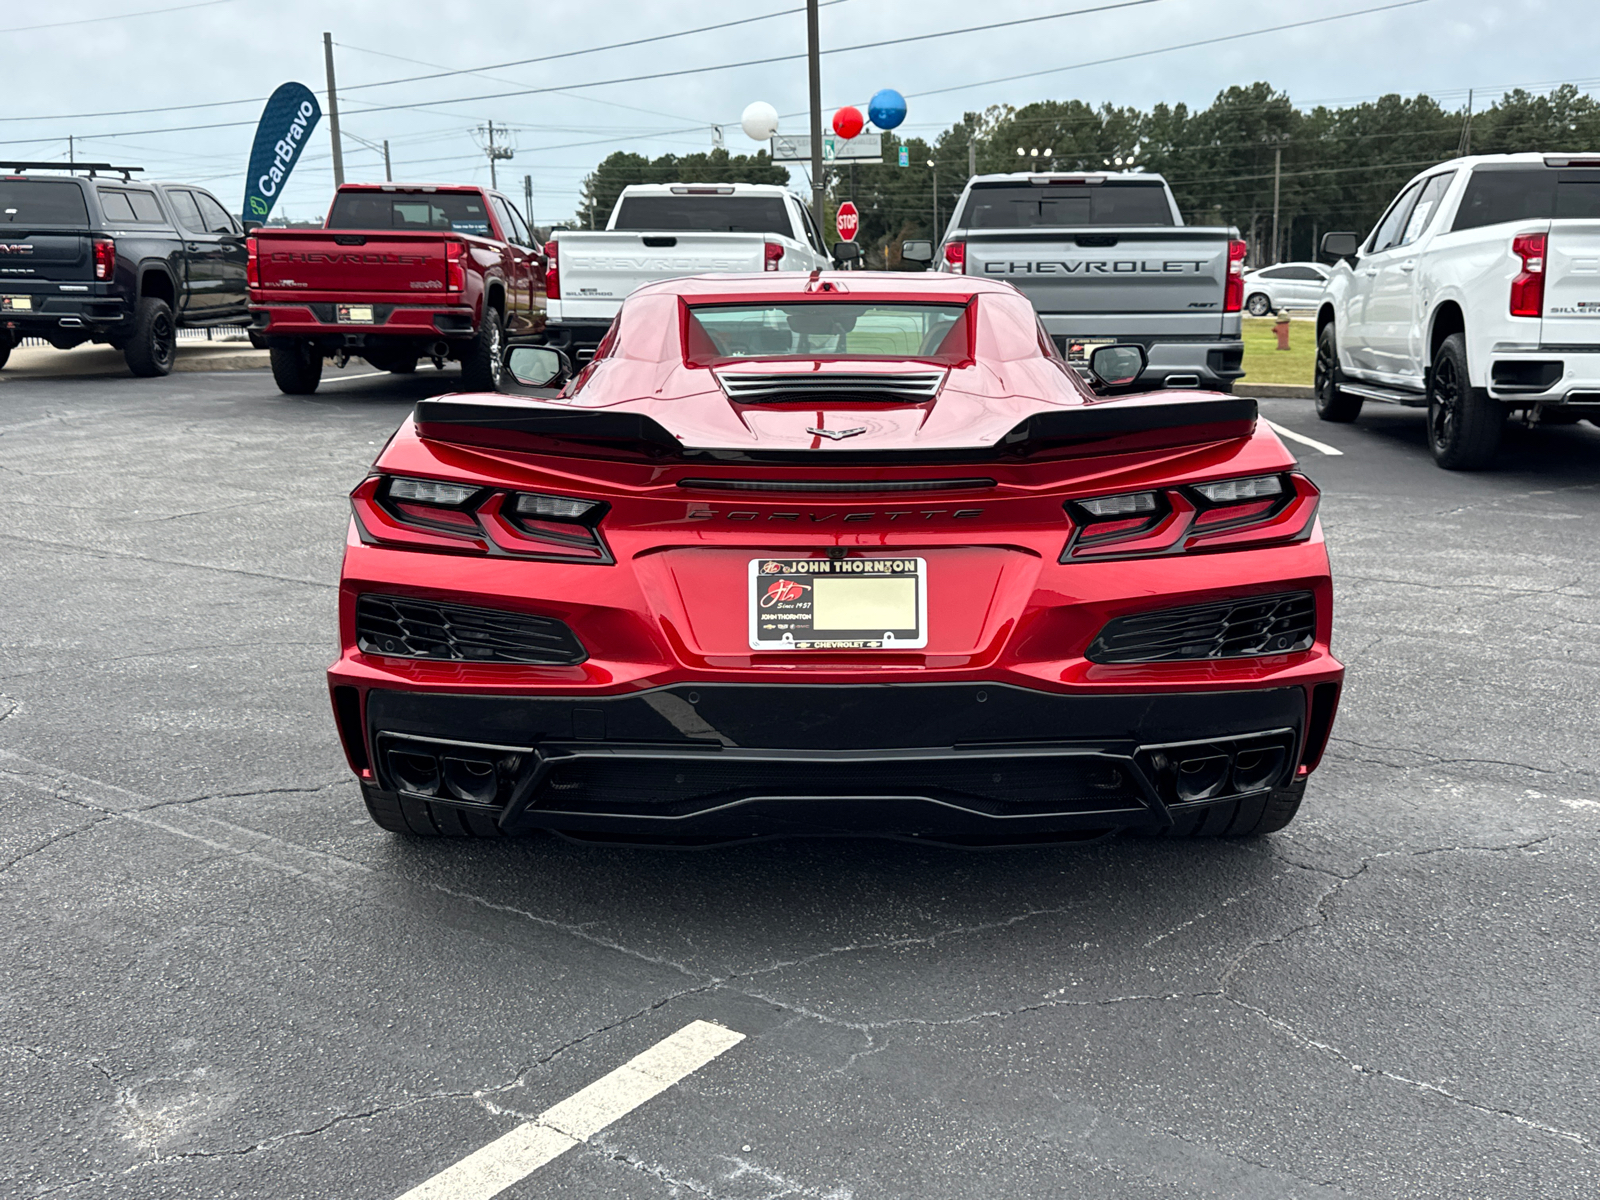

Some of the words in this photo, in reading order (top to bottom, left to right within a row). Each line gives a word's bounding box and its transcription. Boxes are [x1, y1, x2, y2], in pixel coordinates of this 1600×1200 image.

[258, 101, 313, 197] CarBravo
[838, 214, 857, 230] STOP
[0, 244, 34, 254] MC
[271, 252, 433, 265] CHEVROLET
[572, 257, 749, 271] CHEVROLET
[984, 260, 1209, 274] CHEVROLET
[688, 508, 985, 522] CORVETTE
[790, 561, 831, 573] JOHN
[834, 560, 915, 573] THORNTON
[814, 641, 864, 649] CHEVROLET
